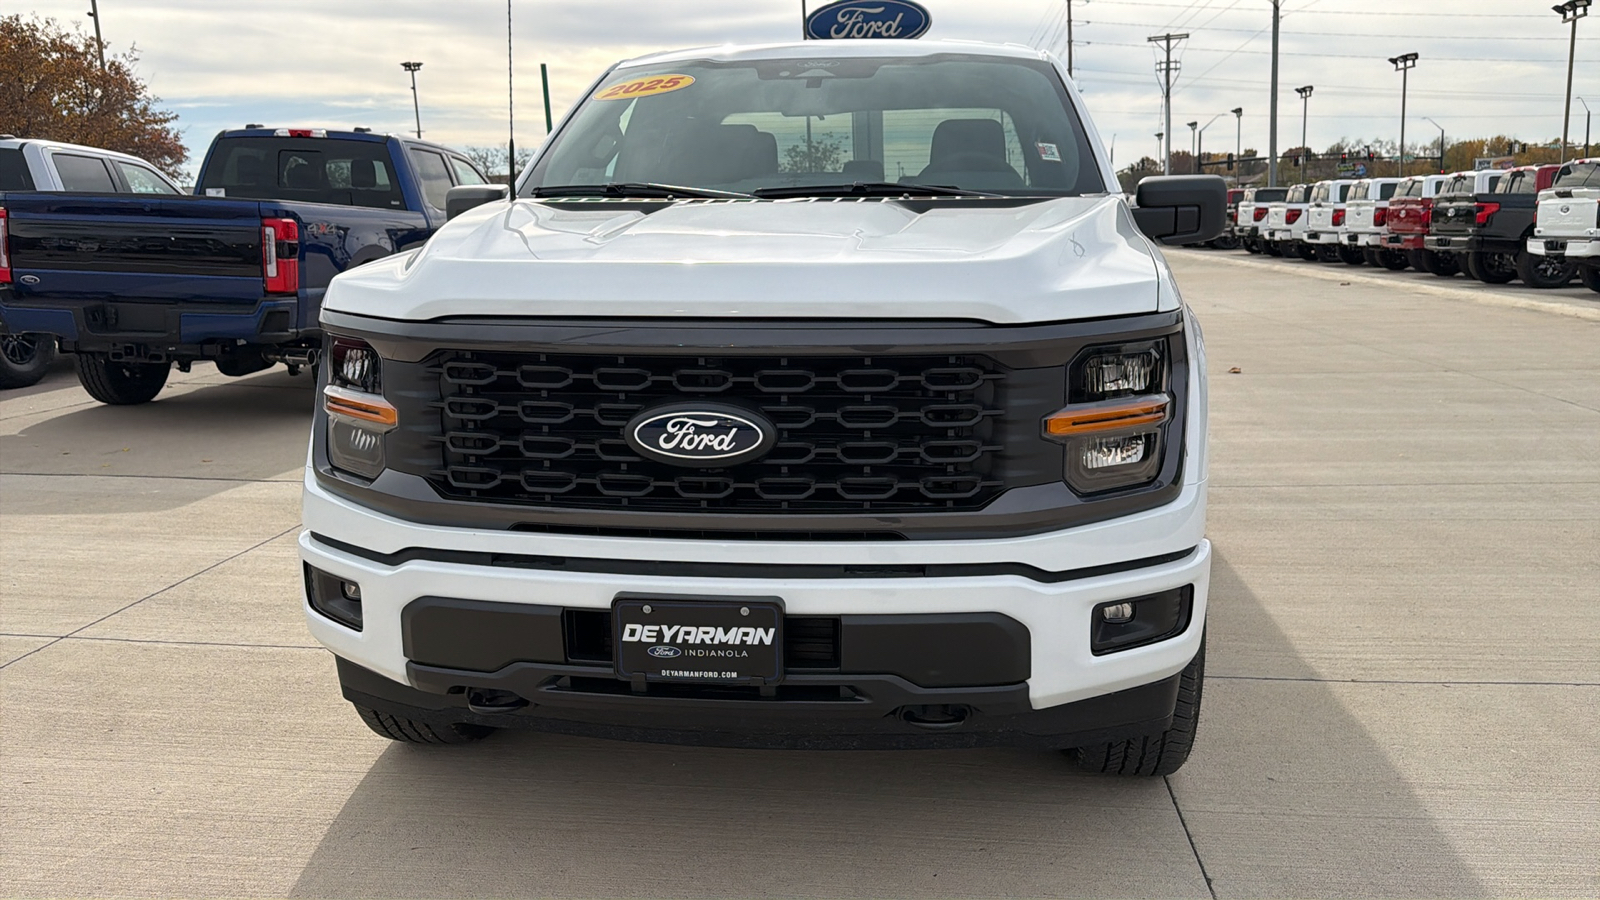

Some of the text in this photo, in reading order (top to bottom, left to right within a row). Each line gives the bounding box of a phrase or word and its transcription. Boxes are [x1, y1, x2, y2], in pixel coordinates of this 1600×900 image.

[830, 6, 904, 39] Ford
[601, 76, 686, 99] 2025
[658, 417, 738, 451] Ford
[622, 623, 776, 646] DEYARMAN
[653, 646, 749, 658] Ford INDIANOLA
[661, 669, 738, 678] DEYARMANFORD.COM
